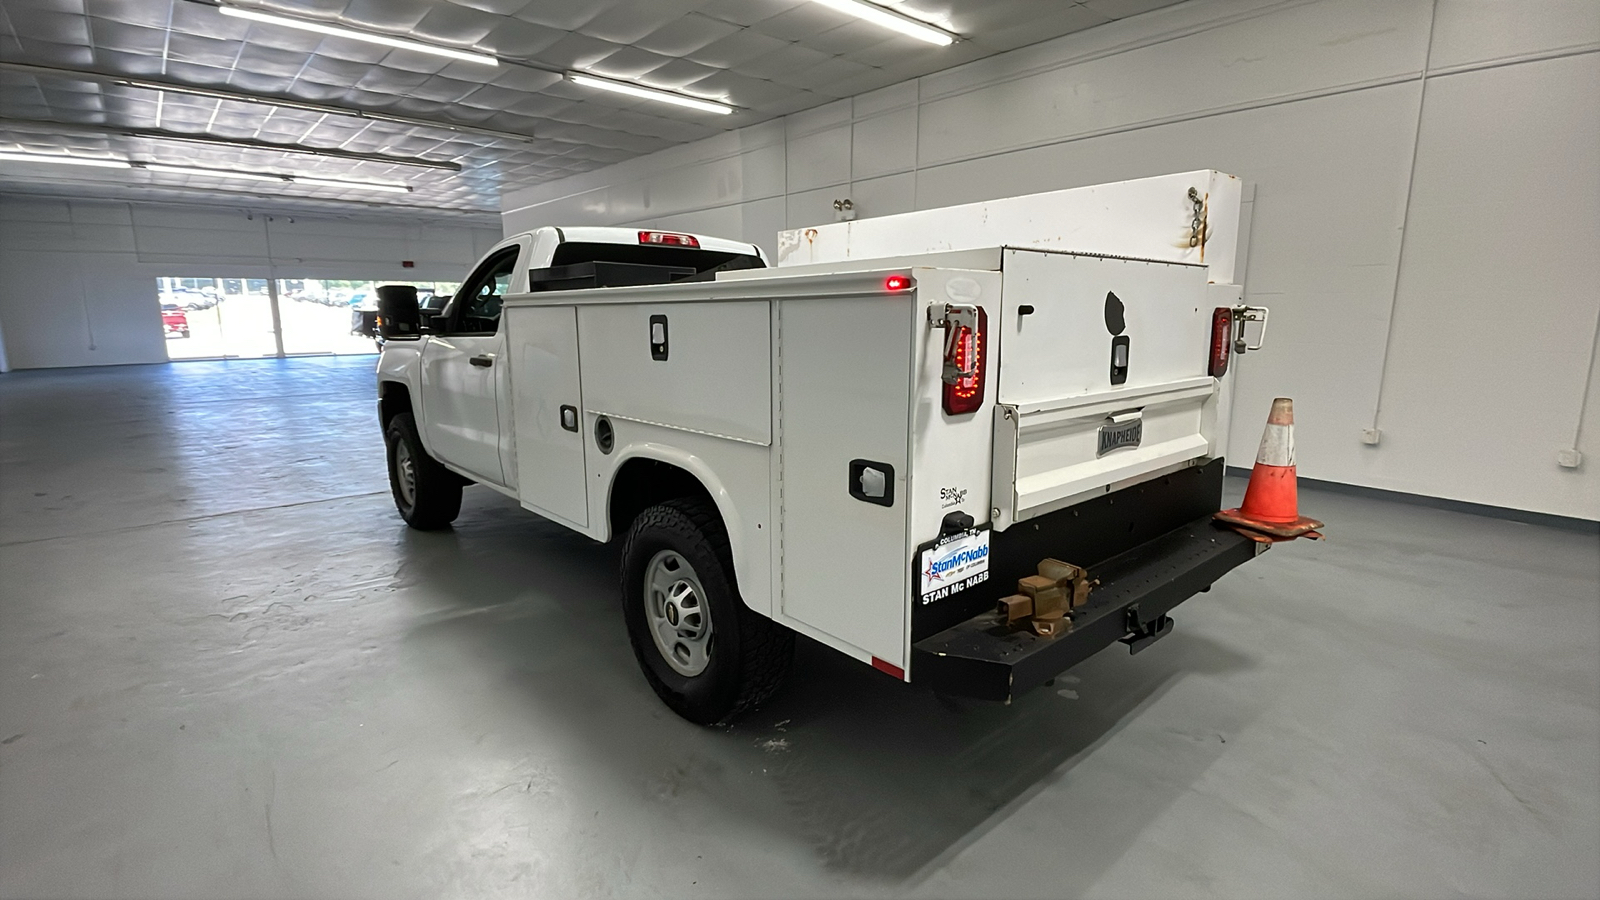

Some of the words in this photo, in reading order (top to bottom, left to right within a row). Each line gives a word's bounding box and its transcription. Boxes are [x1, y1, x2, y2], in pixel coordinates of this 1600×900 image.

[1102, 423, 1141, 451] KNAPHEIDE
[922, 586, 949, 605] STAN
[950, 582, 965, 595] Mc
[966, 570, 989, 588] NABB
